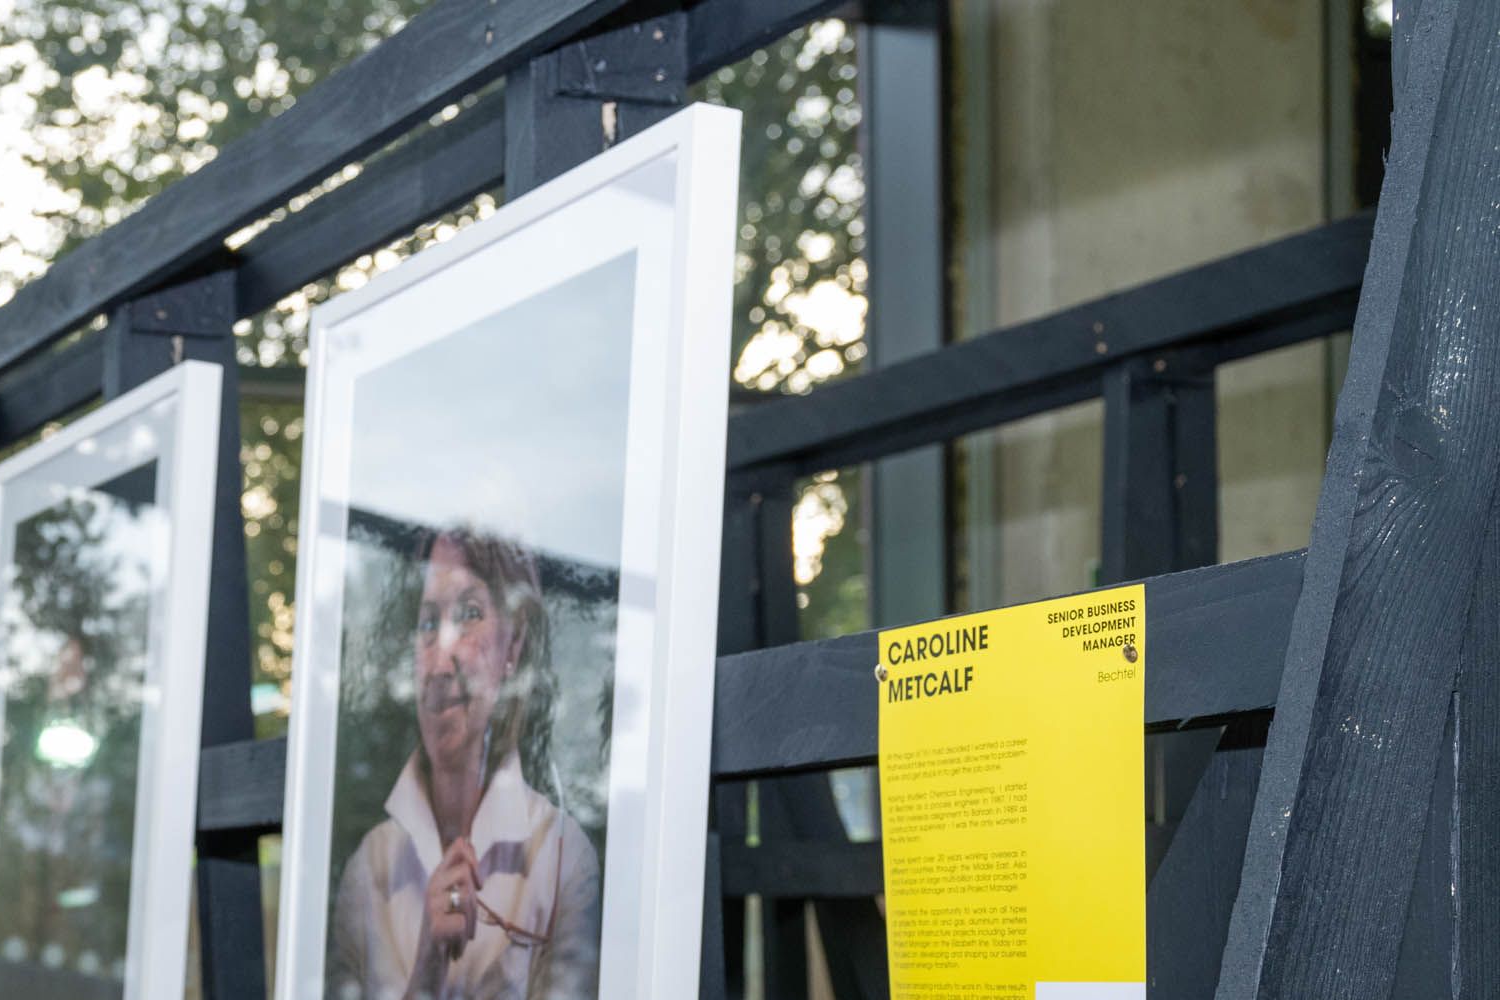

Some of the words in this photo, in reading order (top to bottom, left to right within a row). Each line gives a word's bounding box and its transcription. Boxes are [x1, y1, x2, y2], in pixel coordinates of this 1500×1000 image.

[1047, 608, 1084, 624] SENIOR
[1087, 600, 1135, 617] BUSINESS
[1062, 617, 1136, 638] DEVELOPMENT
[888, 624, 989, 666] CAROLINE
[1083, 634, 1136, 652] MANAGER
[888, 666, 973, 703] METCALF
[1097, 666, 1136, 683] Bechtel
